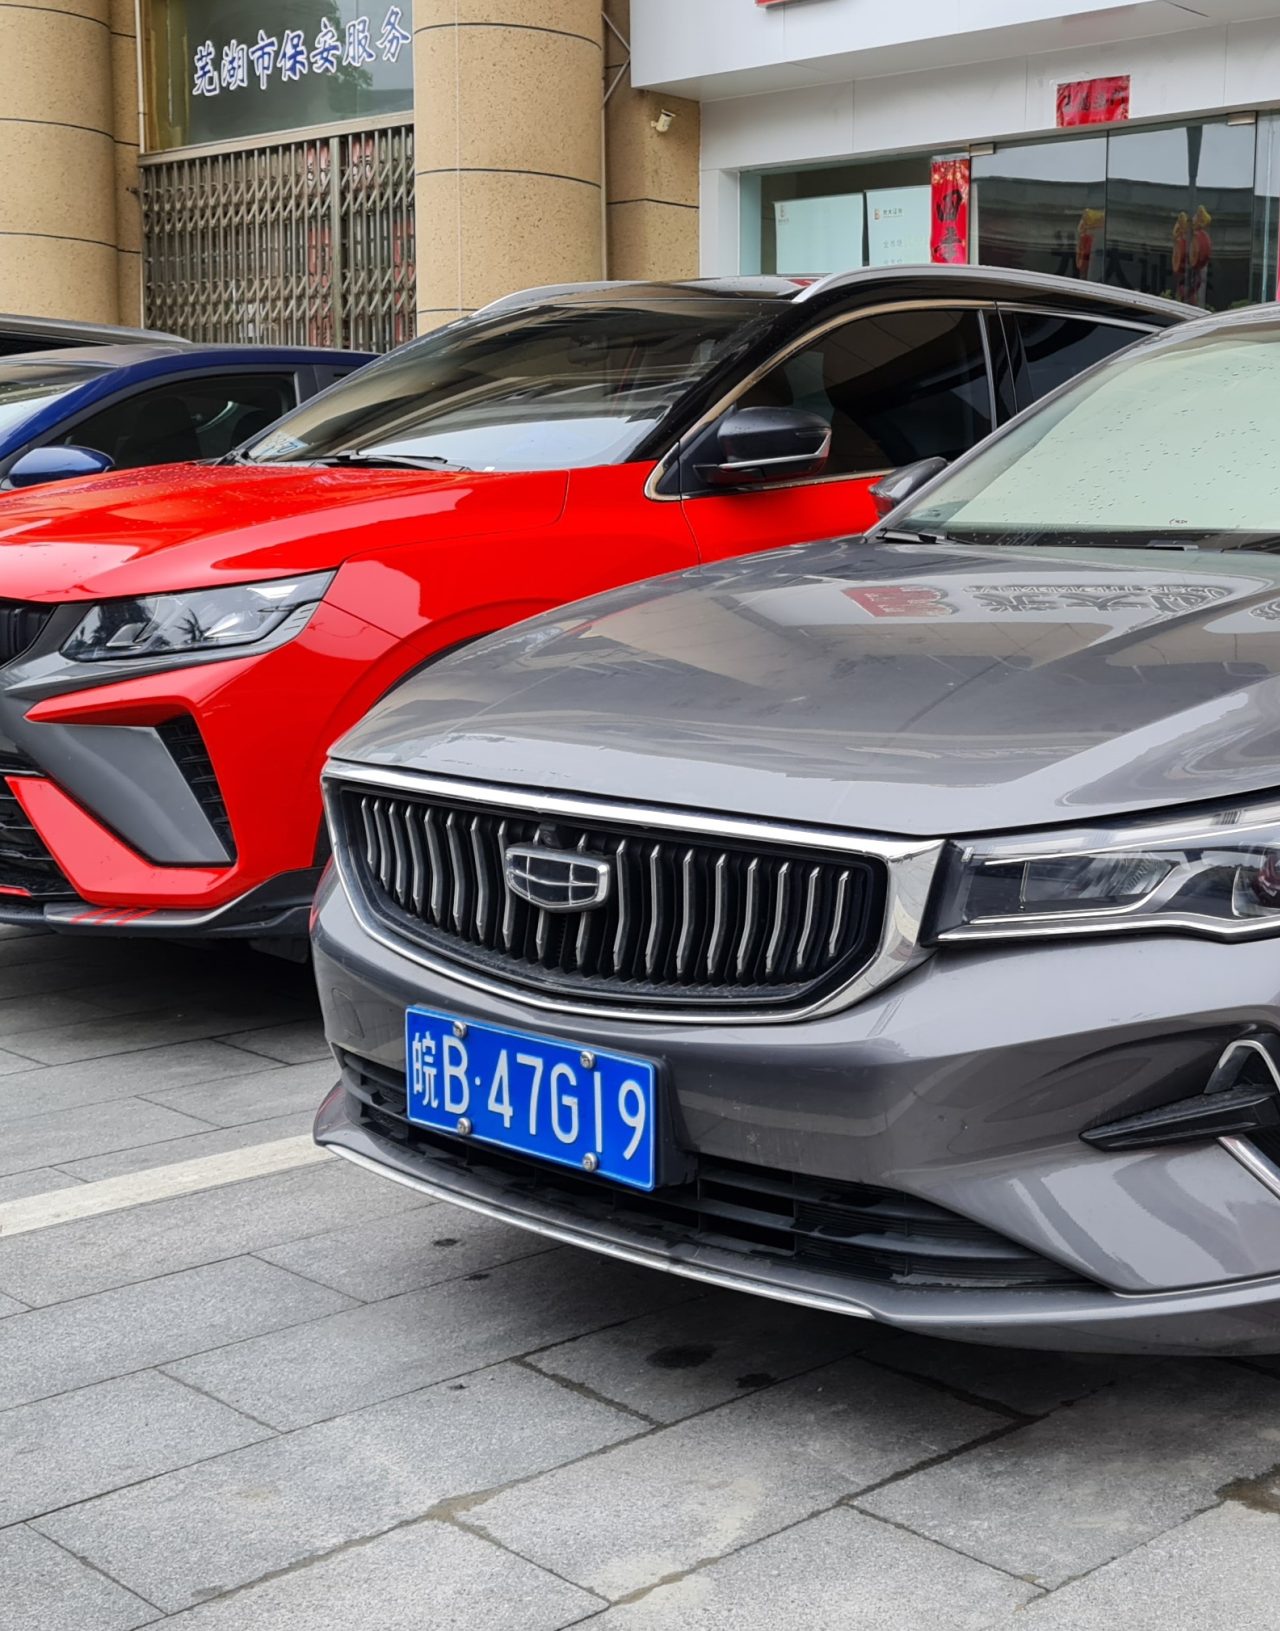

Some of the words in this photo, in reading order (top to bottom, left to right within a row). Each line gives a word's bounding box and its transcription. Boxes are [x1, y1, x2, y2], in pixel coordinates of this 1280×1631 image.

[193, 6, 411, 96] 芜湖市保安服务
